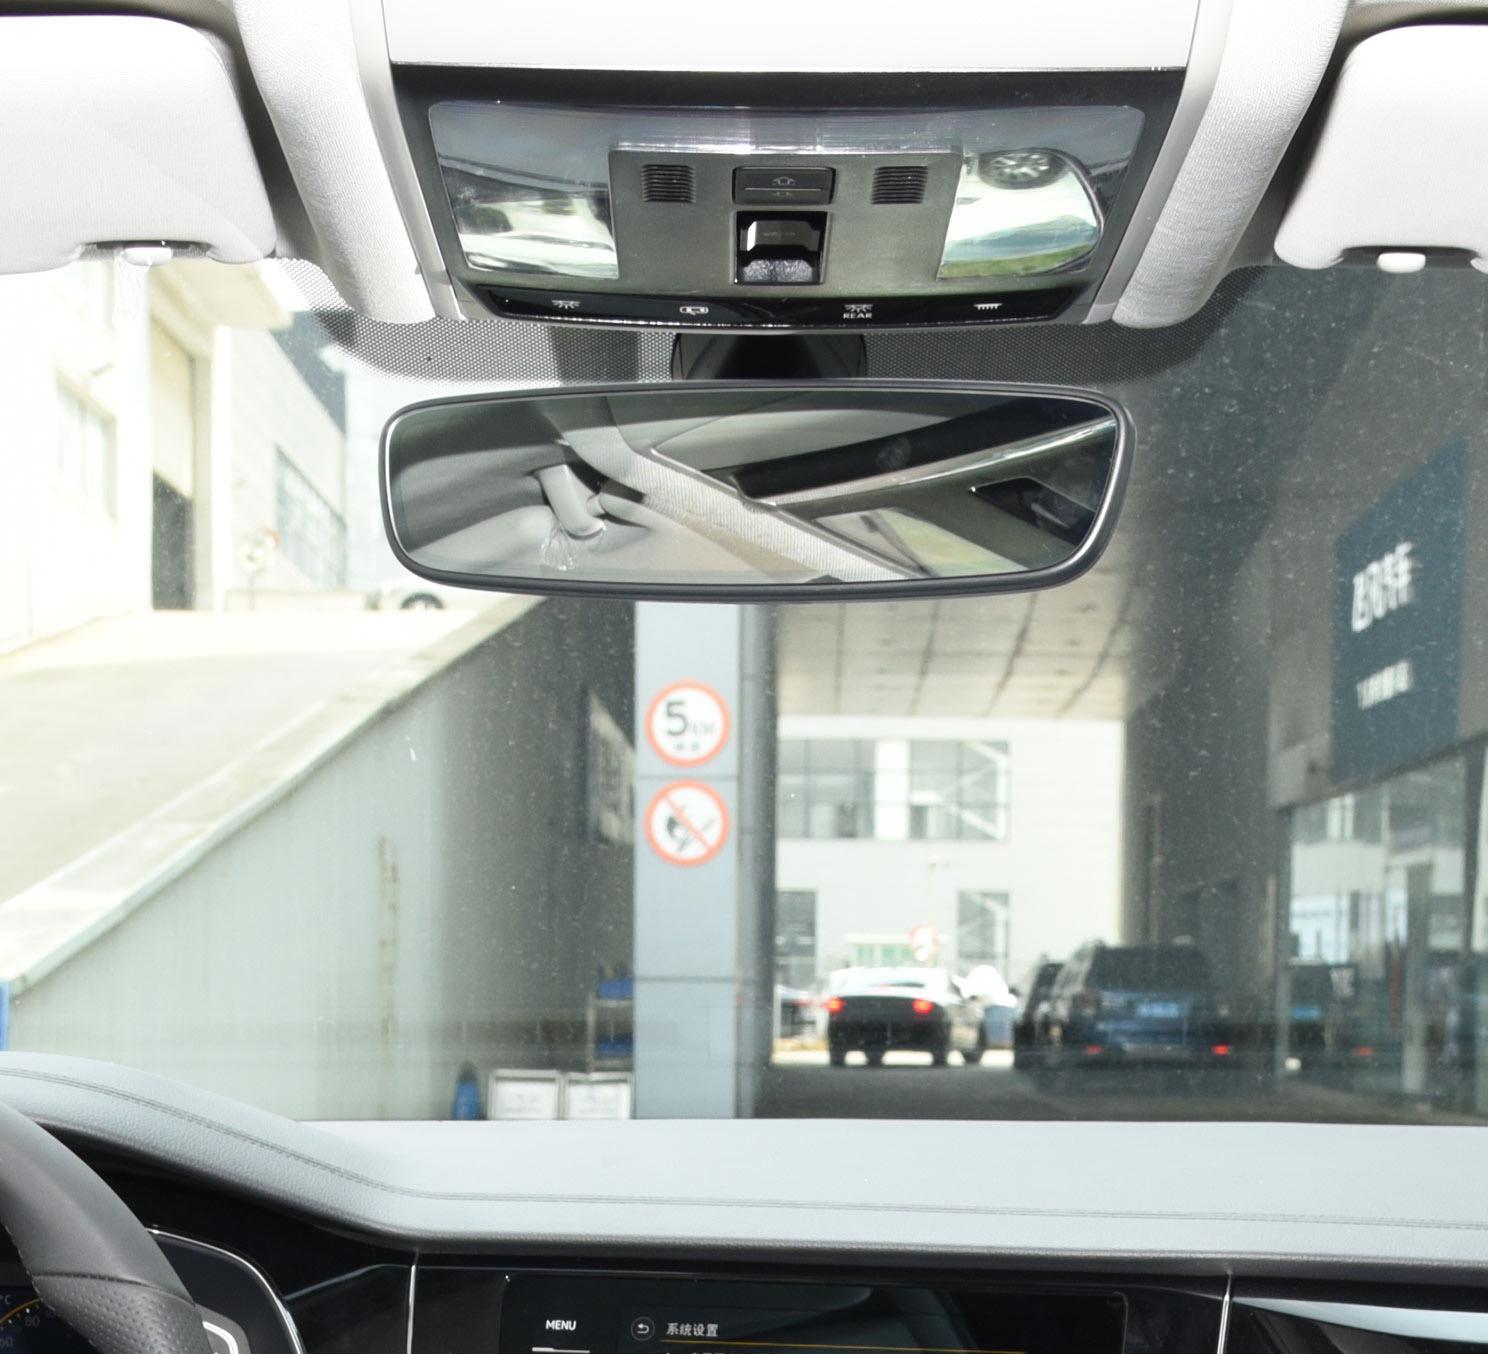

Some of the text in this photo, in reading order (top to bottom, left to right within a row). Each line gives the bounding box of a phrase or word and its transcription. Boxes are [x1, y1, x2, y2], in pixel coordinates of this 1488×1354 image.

[545, 1319, 577, 1331] MENU
[666, 1321, 719, 1338] 系统设置
